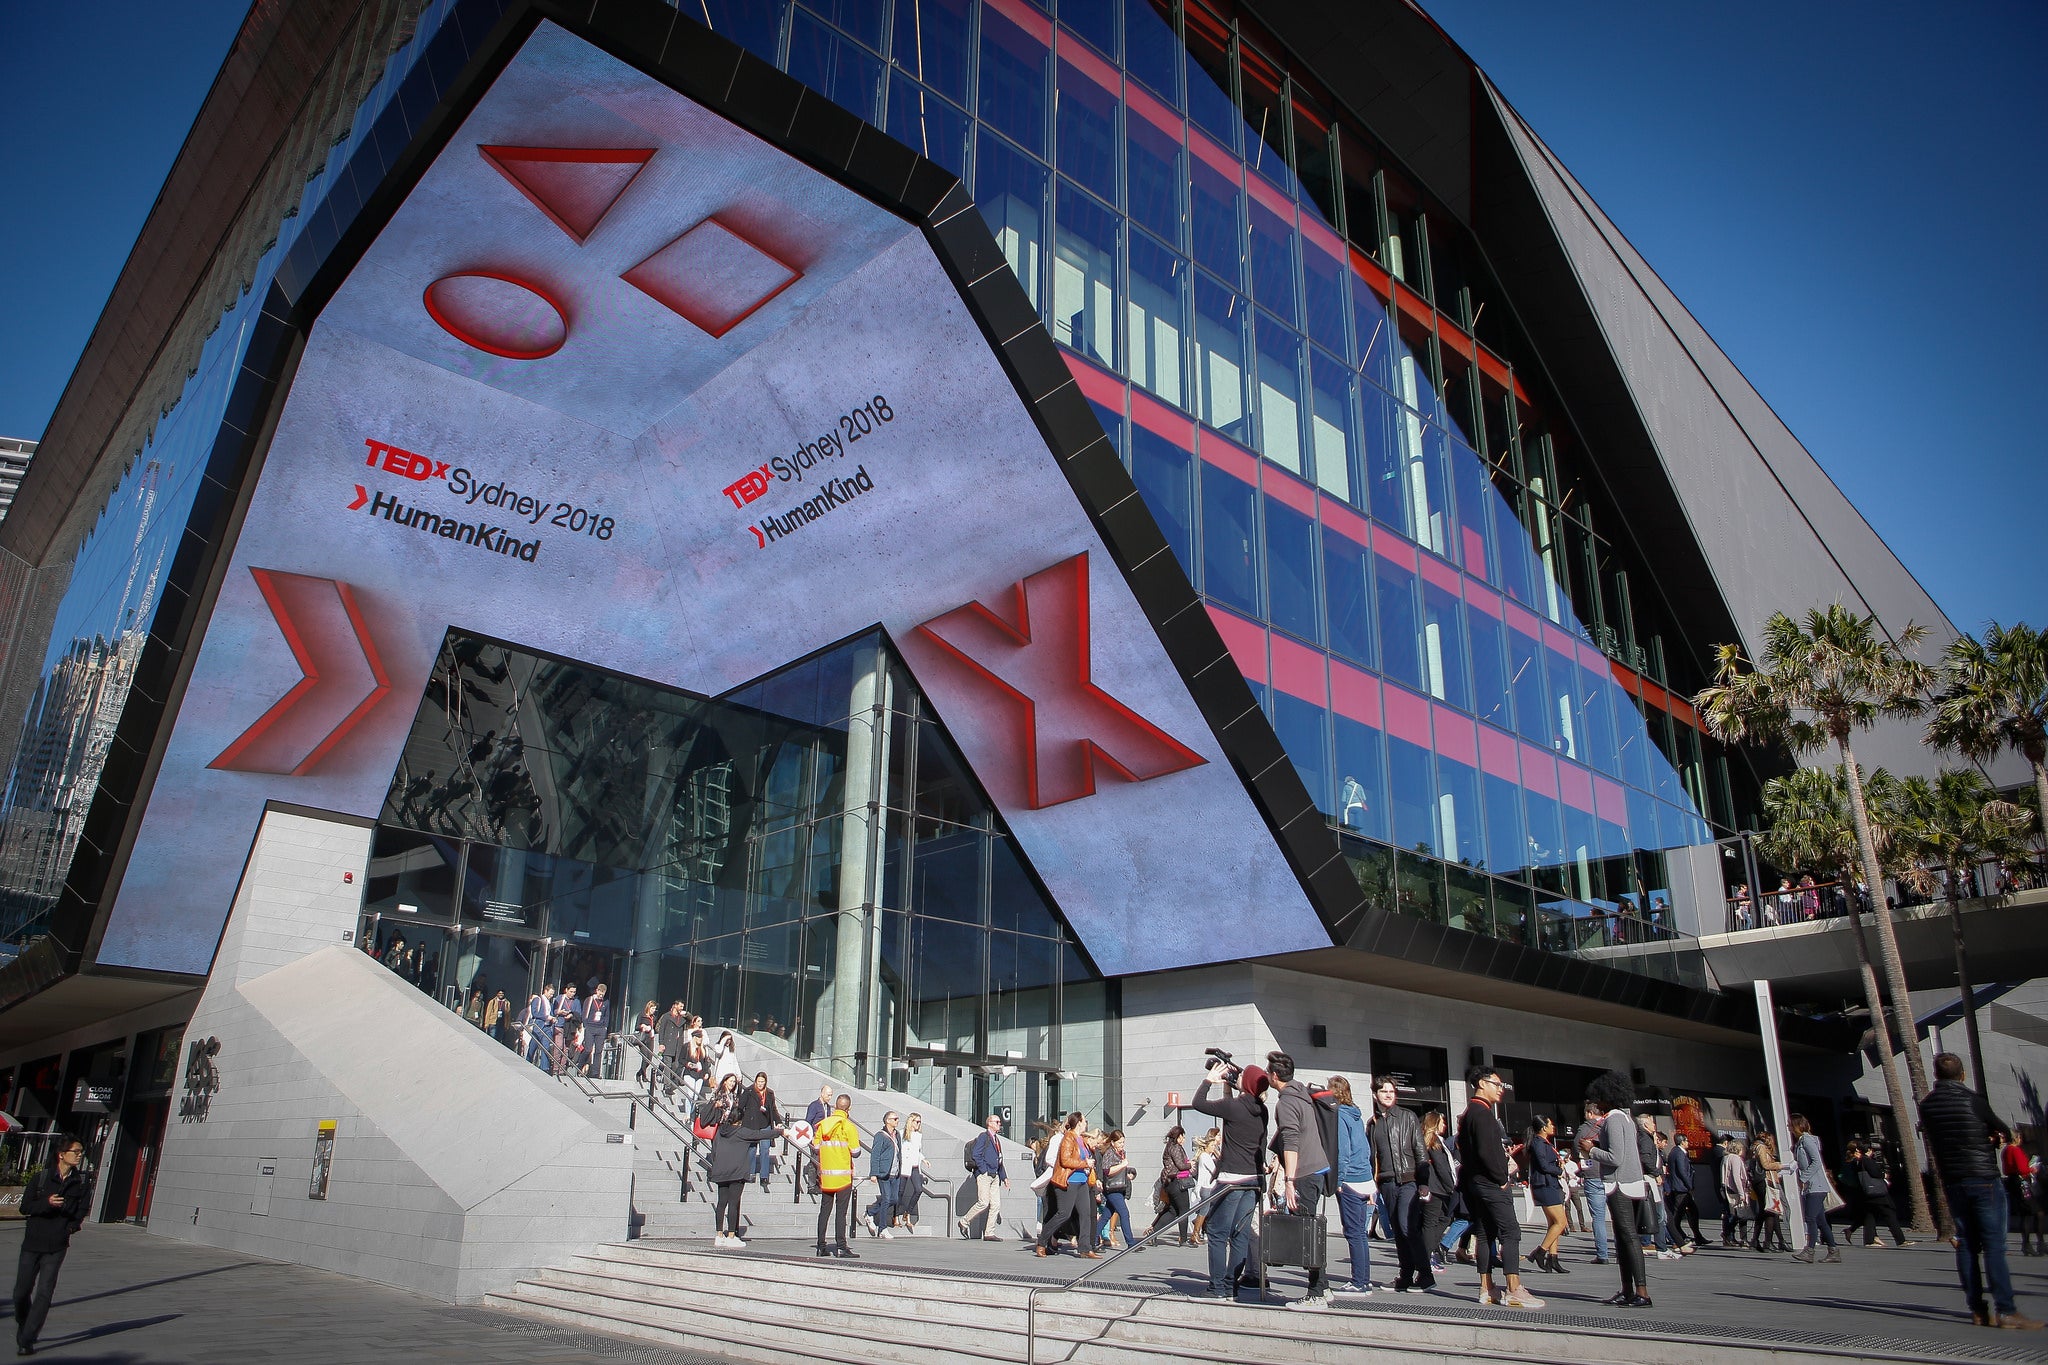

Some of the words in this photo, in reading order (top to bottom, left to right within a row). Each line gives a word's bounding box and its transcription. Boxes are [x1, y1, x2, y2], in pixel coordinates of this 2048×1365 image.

[839, 395, 894, 443] 2018
[369, 490, 542, 563] HumanKind
[551, 502, 616, 541] 2018
[759, 464, 875, 542] HumanKind
